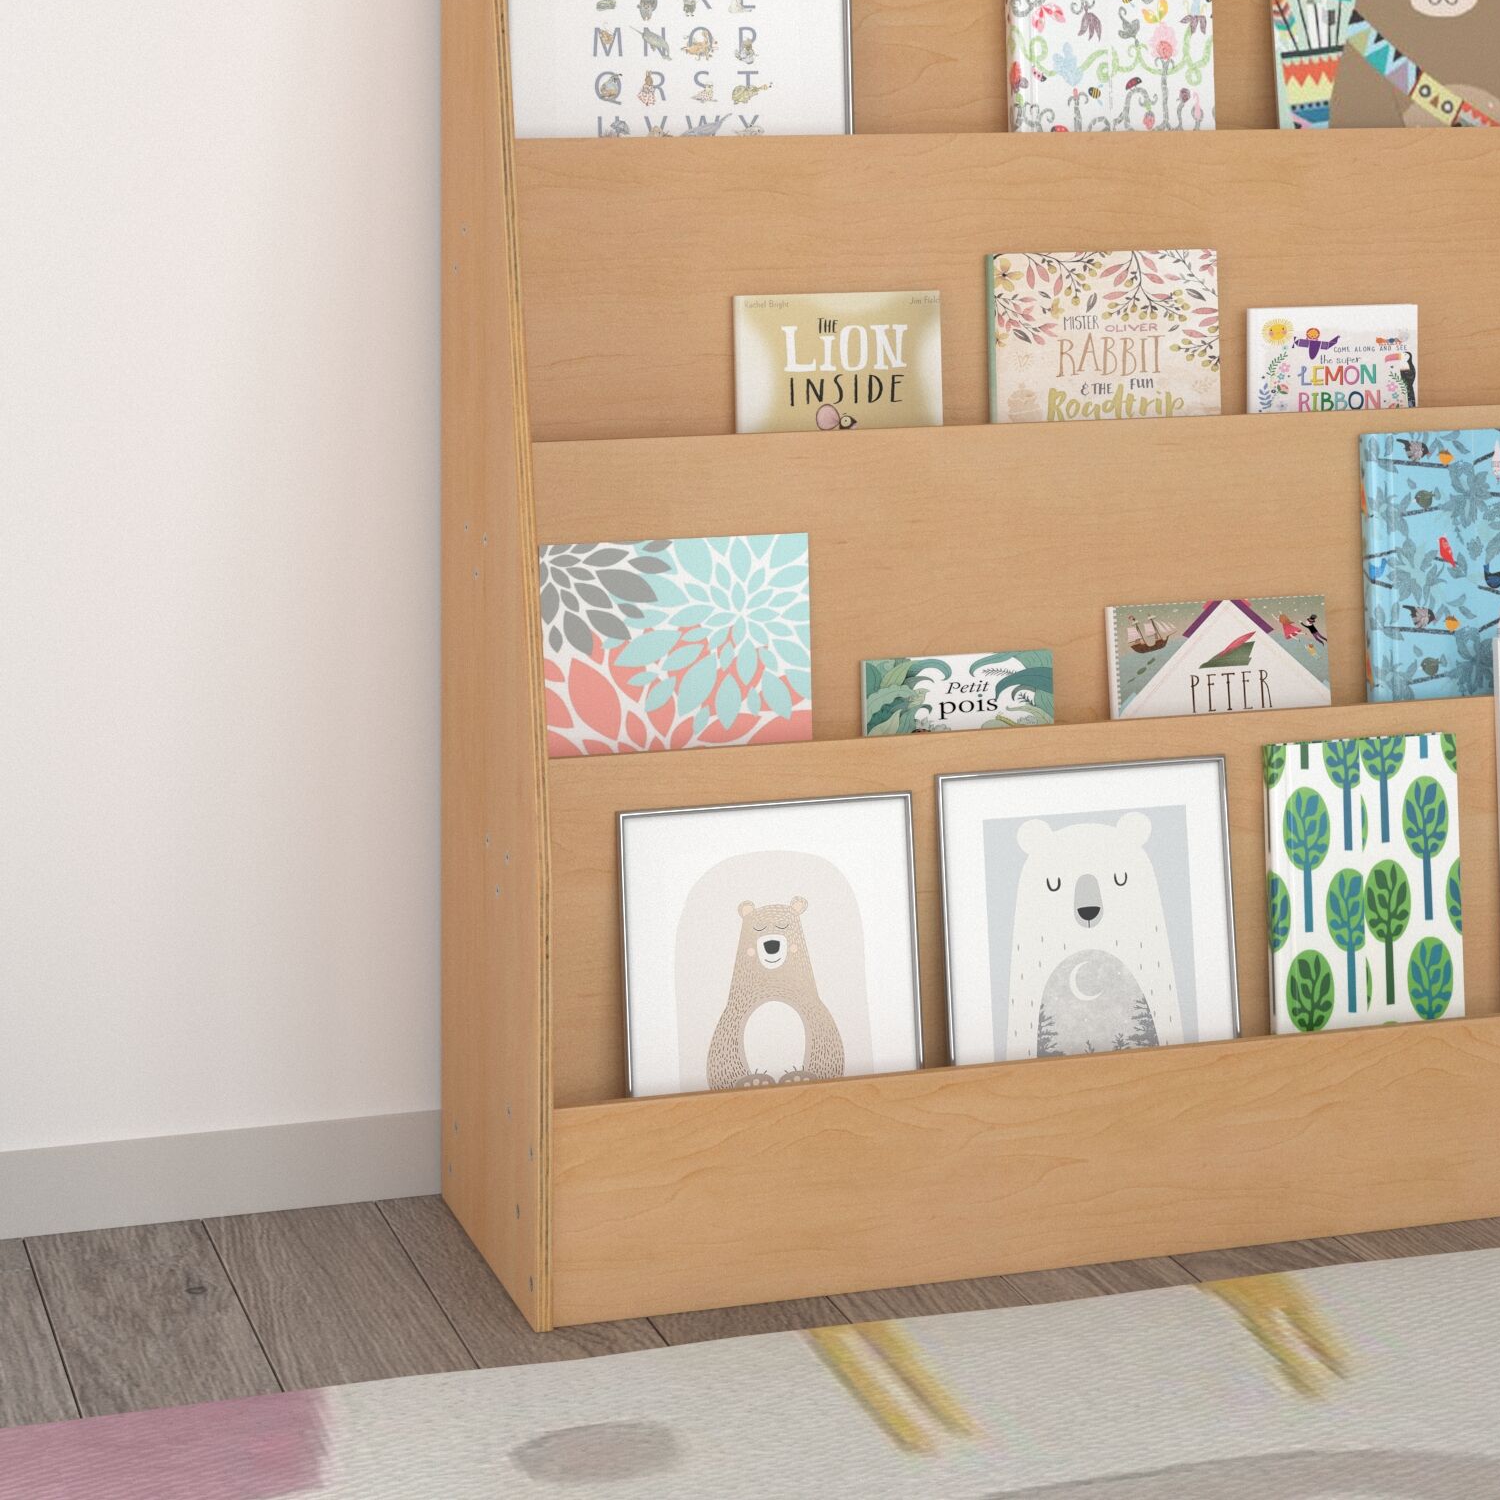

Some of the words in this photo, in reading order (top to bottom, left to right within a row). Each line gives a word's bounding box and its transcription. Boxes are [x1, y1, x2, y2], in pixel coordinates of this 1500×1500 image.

[593, 27, 623, 57] M
[643, 27, 666, 57] N
[688, 26, 713, 57] O
[739, 27, 757, 56] P
[594, 71, 622, 105] Q
[648, 71, 666, 101] R
[693, 70, 710, 100] S
[737, 71, 759, 99] T
[768, 300, 789, 310] Bright
[910, 297, 922, 305] Jim
[817, 317, 838, 334] THE
[1063, 315, 1099, 331] MISTER
[1105, 323, 1158, 333] OLIVER
[1056, 333, 1165, 378] RABBIT
[1320, 355, 1334, 364] the
[1336, 357, 1361, 365] super
[1298, 364, 1377, 386] LEMON
[790, 374, 905, 406] INSIDE
[1091, 383, 1113, 394] THE
[1047, 384, 1184, 422] Roadtrip
[1298, 390, 1381, 412] RIBBON
[945, 680, 990, 694] Petit
[1190, 669, 1272, 713] PETER
[939, 694, 998, 720] pois
